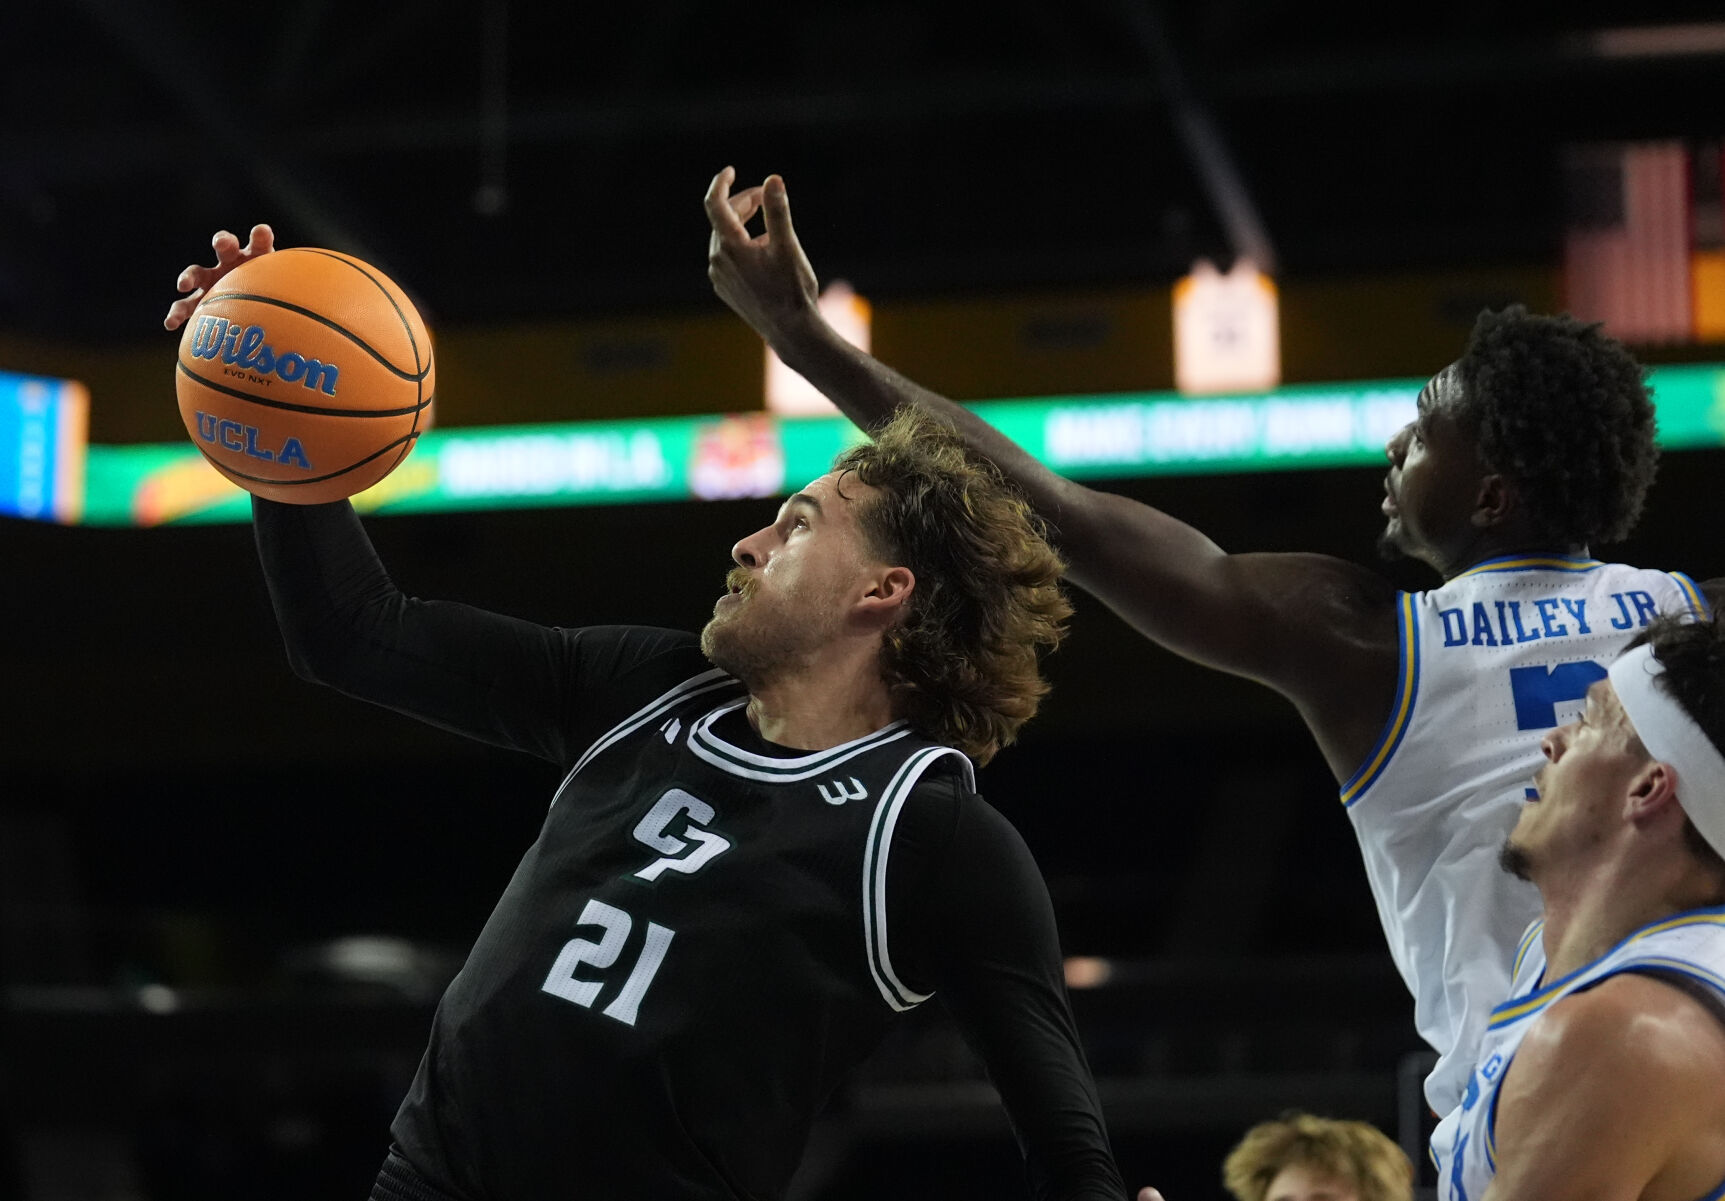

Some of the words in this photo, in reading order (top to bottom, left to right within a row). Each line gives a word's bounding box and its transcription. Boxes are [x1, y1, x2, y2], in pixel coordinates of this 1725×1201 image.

[191, 315, 339, 397] Wilson
[224, 369, 246, 379] EVO
[248, 375, 272, 386] NXT
[195, 411, 313, 470] UCLA
[1438, 599, 1592, 648] DAILEY
[541, 899, 676, 1026] 21
